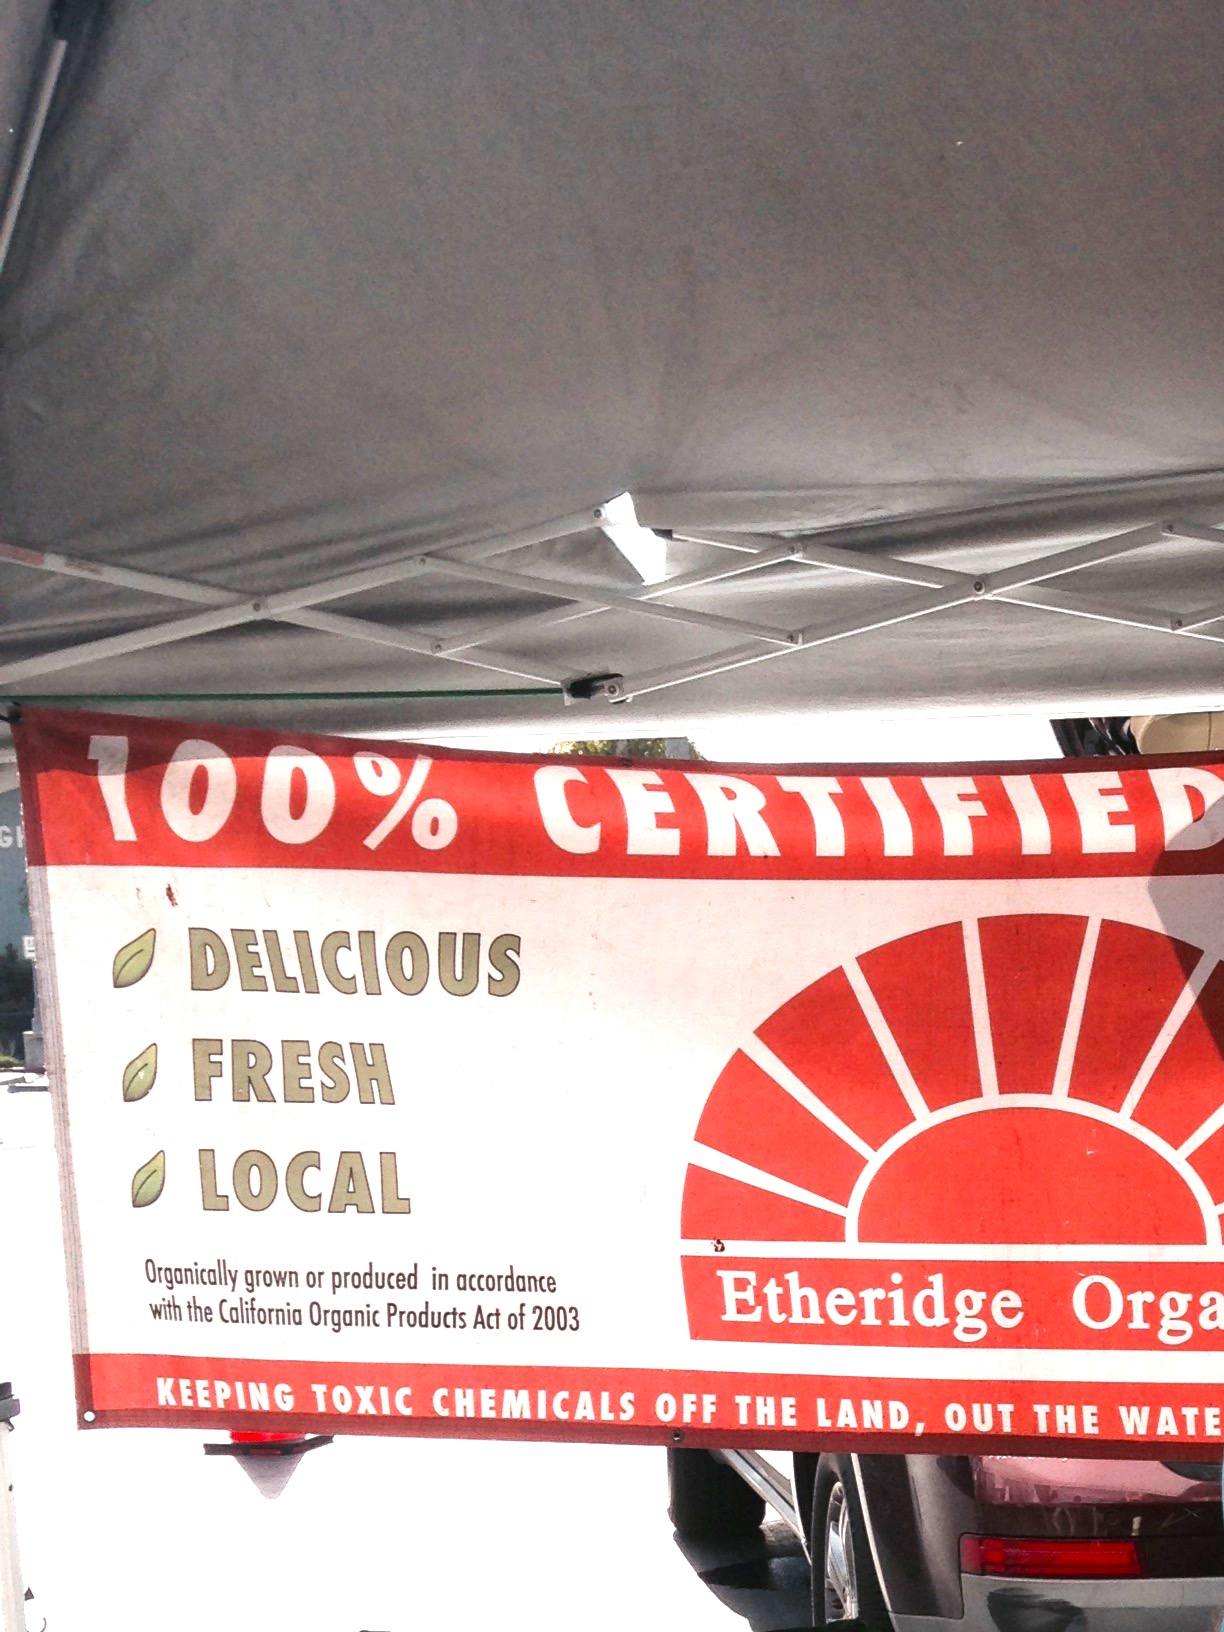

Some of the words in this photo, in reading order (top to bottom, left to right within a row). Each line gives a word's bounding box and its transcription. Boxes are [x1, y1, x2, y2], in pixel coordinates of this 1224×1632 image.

[87, 734, 458, 850] 100%
[188, 926, 522, 997] DELICIOUS
[192, 1039, 396, 1105] FRESH
[198, 1148, 411, 1214] LOCAL
[145, 1258, 238, 1293] Organically
[244, 1269, 299, 1293] grown
[306, 1270, 325, 1288] or
[331, 1261, 418, 1295] produced
[431, 1266, 449, 1291] in
[456, 1264, 557, 1293] accordance
[716, 1270, 1025, 1343] Etheridge
[149, 1294, 183, 1322] with
[187, 1295, 214, 1323] the
[218, 1297, 303, 1326] California
[309, 1300, 381, 1334] Organic
[386, 1300, 467, 1329] Products
[473, 1304, 501, 1330] Act
[507, 1302, 527, 1330] of
[532, 1305, 580, 1331] 2003
[156, 1377, 295, 1412] KEEPING
[311, 1384, 413, 1416] TOXIC
[432, 1387, 636, 1421] CHEMICALS
[655, 1392, 717, 1424] OFF
[734, 1395, 797, 1426] THE
[816, 1397, 925, 1437] LAND,
[944, 1402, 1014, 1433] OUT
[1033, 1404, 1099, 1435] THE
